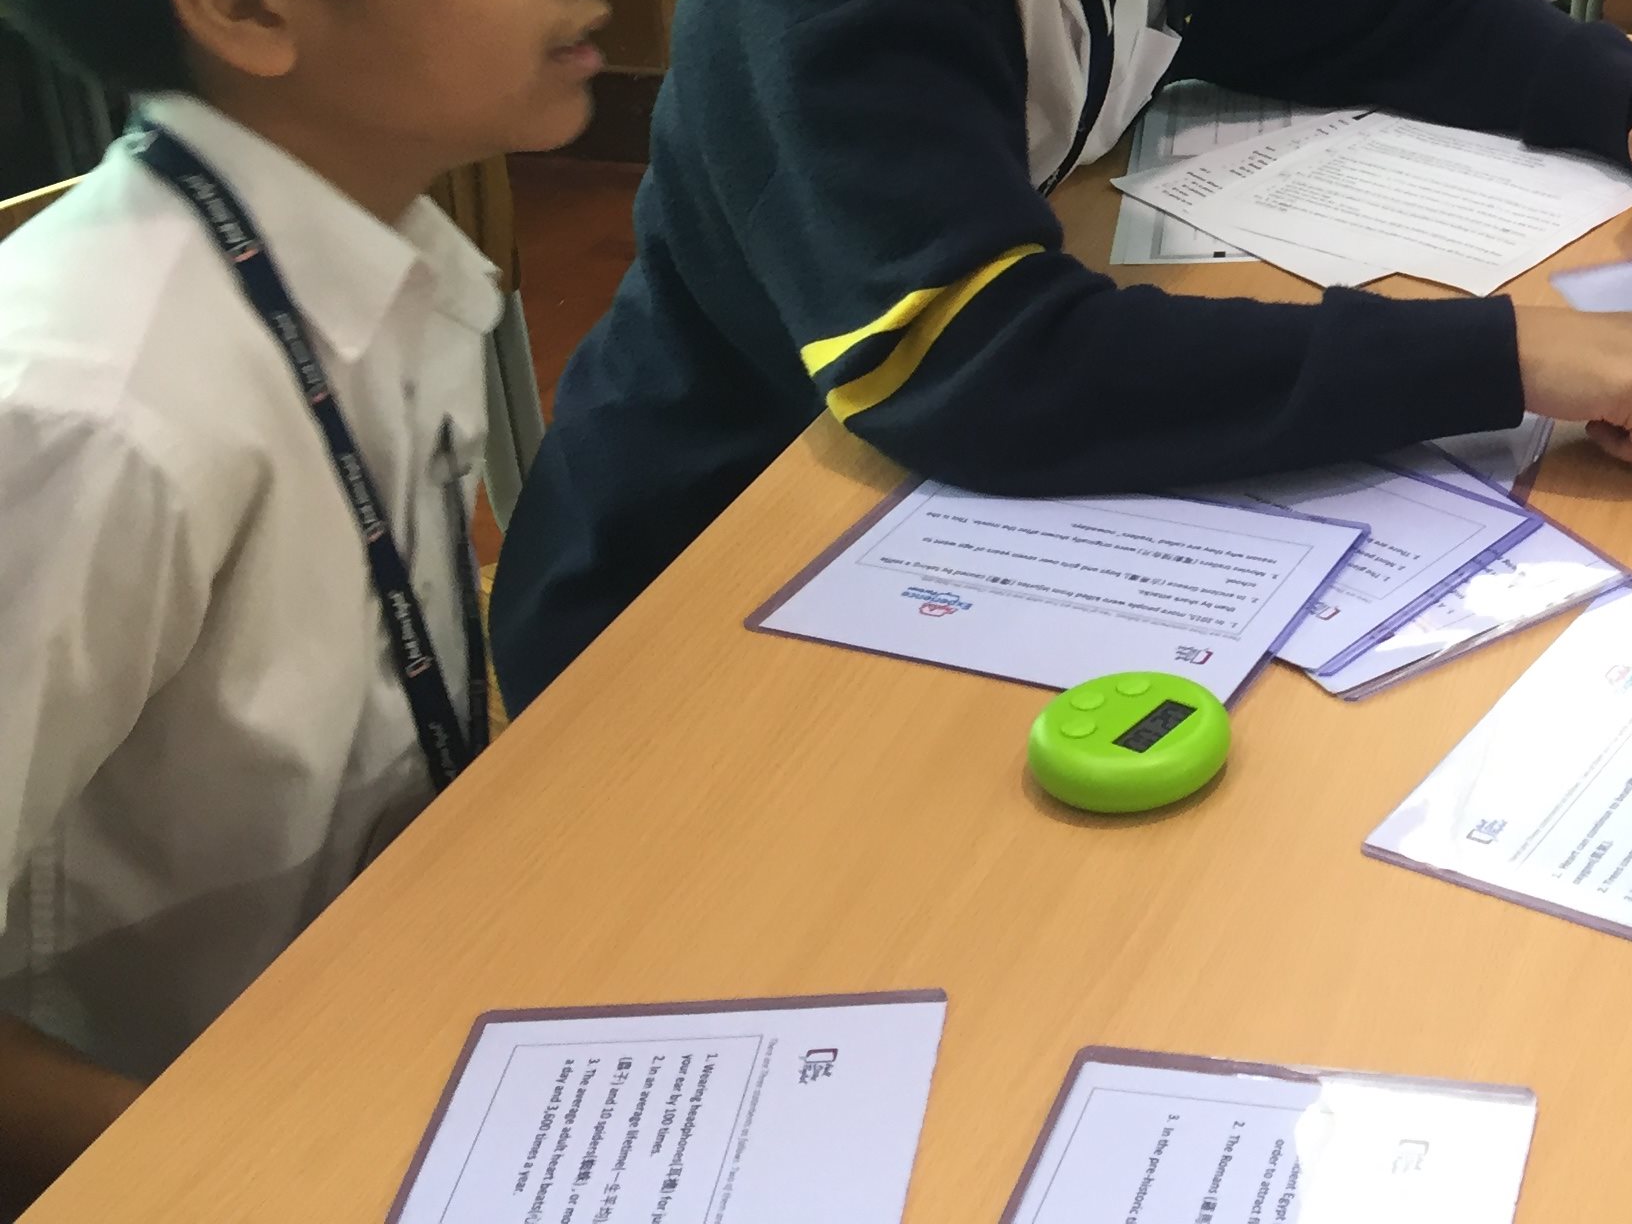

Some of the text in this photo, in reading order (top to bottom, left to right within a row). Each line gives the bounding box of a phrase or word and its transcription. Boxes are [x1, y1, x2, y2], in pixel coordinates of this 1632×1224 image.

[1078, 564, 1100, 573] and
[1099, 597, 1127, 607] were
[1125, 601, 1161, 613] people
[645, 1065, 662, 1075] In
[675, 1054, 695, 1074] your
[553, 1066, 575, 1083] day
[576, 1069, 597, 1085] The
[640, 1077, 658, 1089] an
[689, 1063, 715, 1102] Wearing
[669, 1076, 687, 1092] ear
[546, 1084, 567, 1103] and
[602, 1087, 623, 1105] and
[665, 1093, 681, 1105] by
[561, 1087, 590, 1124] average
[626, 1090, 653, 1127] average
[535, 1104, 559, 1131] 3,600
[658, 1107, 677, 1125] 100
[523, 1132, 549, 1160] times
[550, 1126, 575, 1152] adult
[1152, 1138, 1170, 1155] the
[1222, 1134, 1241, 1152] The
[540, 1153, 565, 1180] heart
[1207, 1154, 1233, 1194] Romans
[1127, 1156, 1161, 1214] pre-historic
[1249, 1138, 1286, 1214] order to attract
[654, 1195, 673, 1210] for
[1273, 1192, 1295, 1221] Egypt
